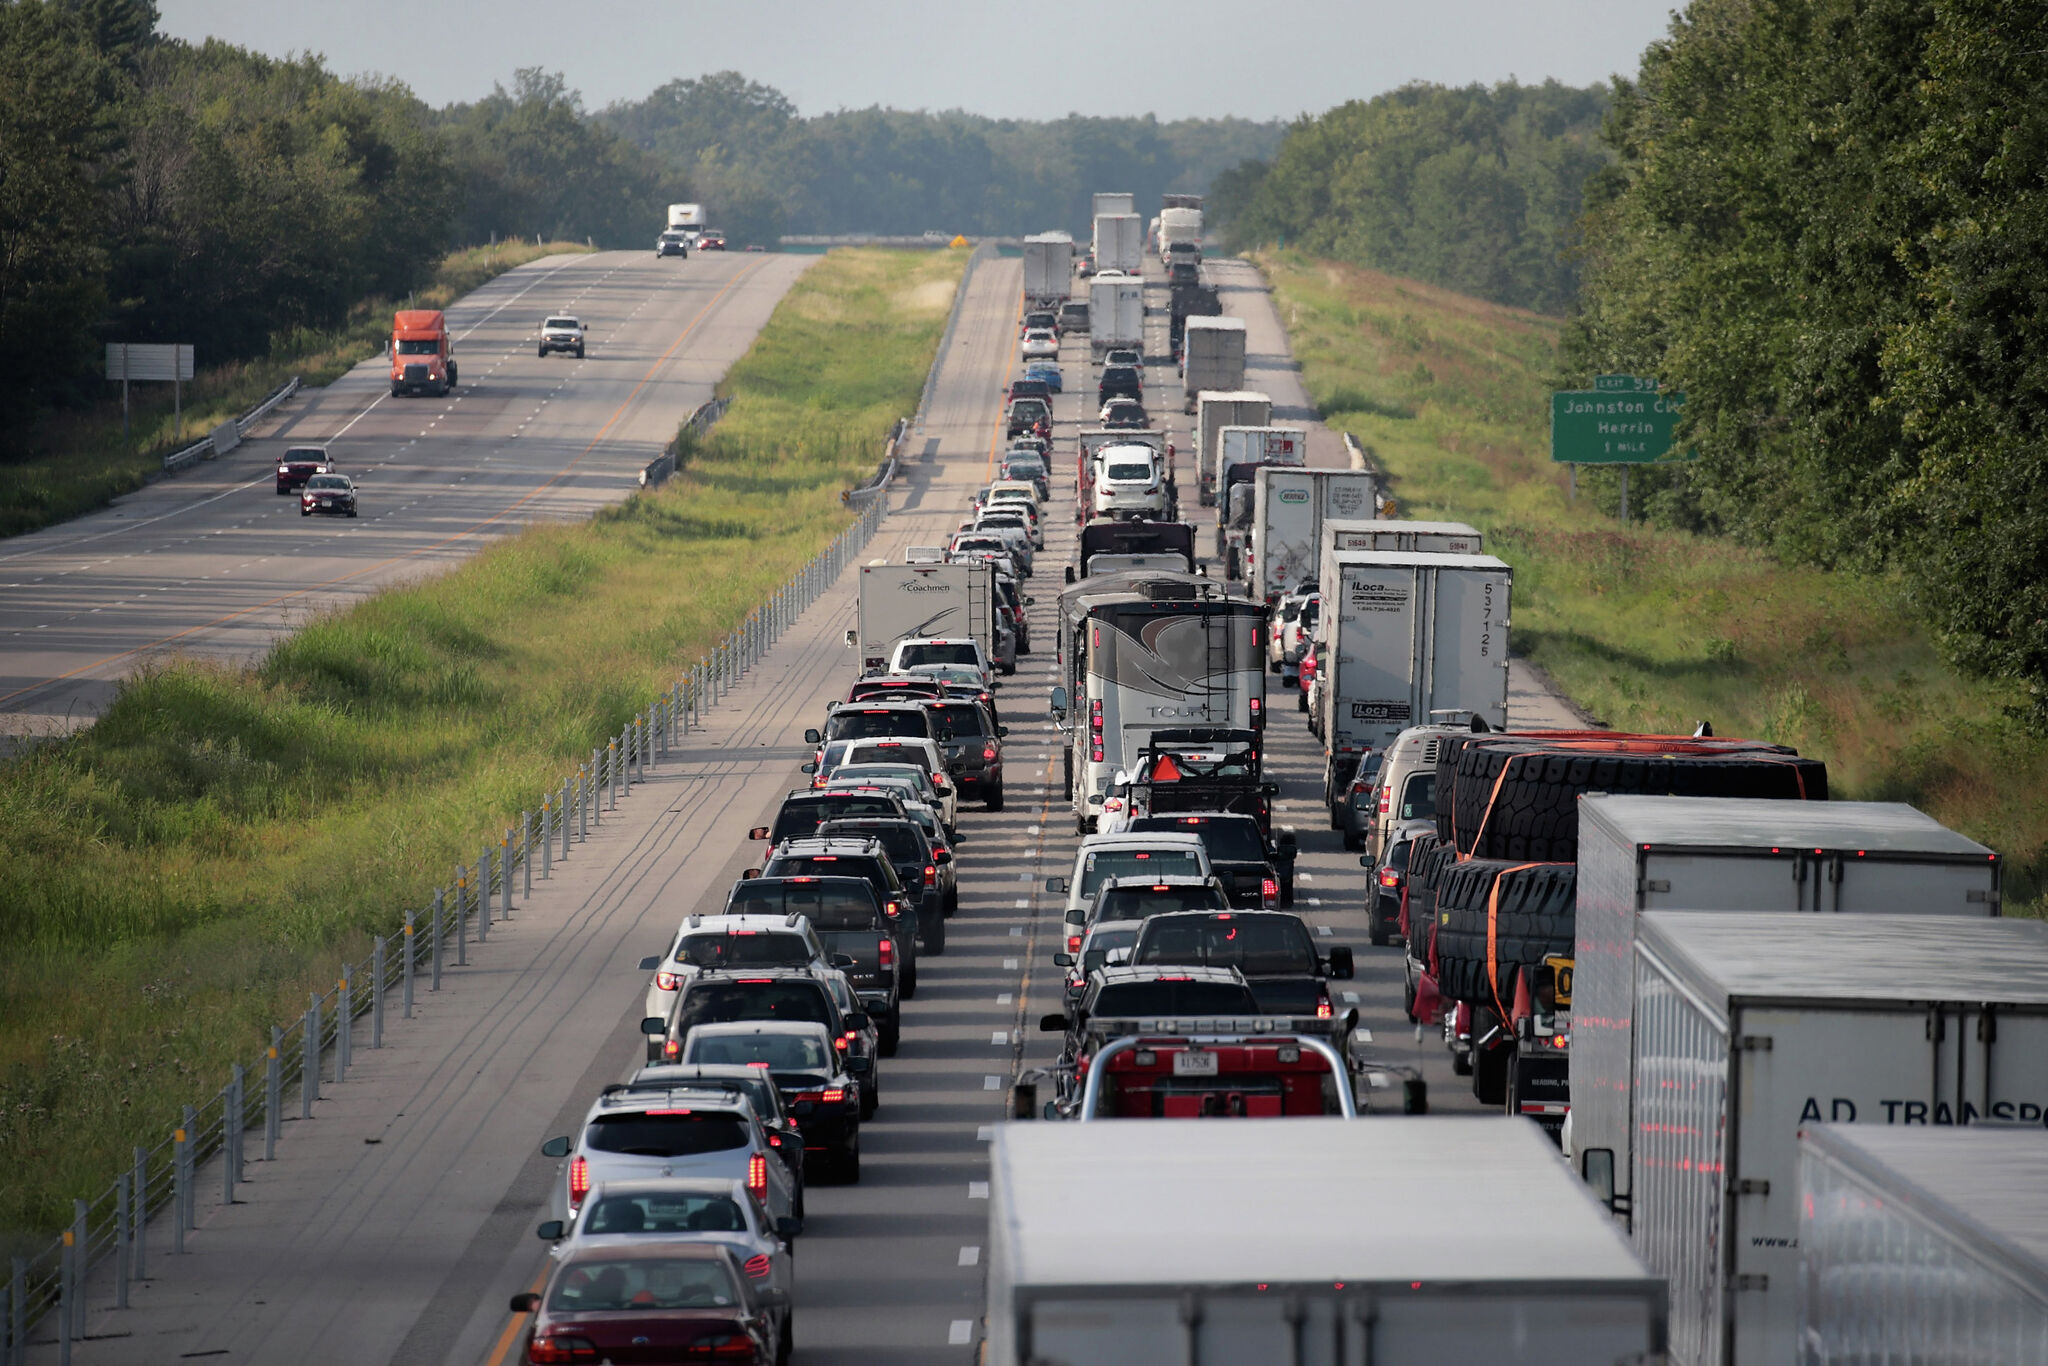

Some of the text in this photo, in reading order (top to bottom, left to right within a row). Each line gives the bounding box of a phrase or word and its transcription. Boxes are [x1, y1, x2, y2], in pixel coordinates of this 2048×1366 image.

[1564, 400, 1645, 414] Johnston
[1598, 422, 1654, 434] Herrin
[1618, 442, 1645, 452] MILE
[906, 584, 950, 592] Coachmen
